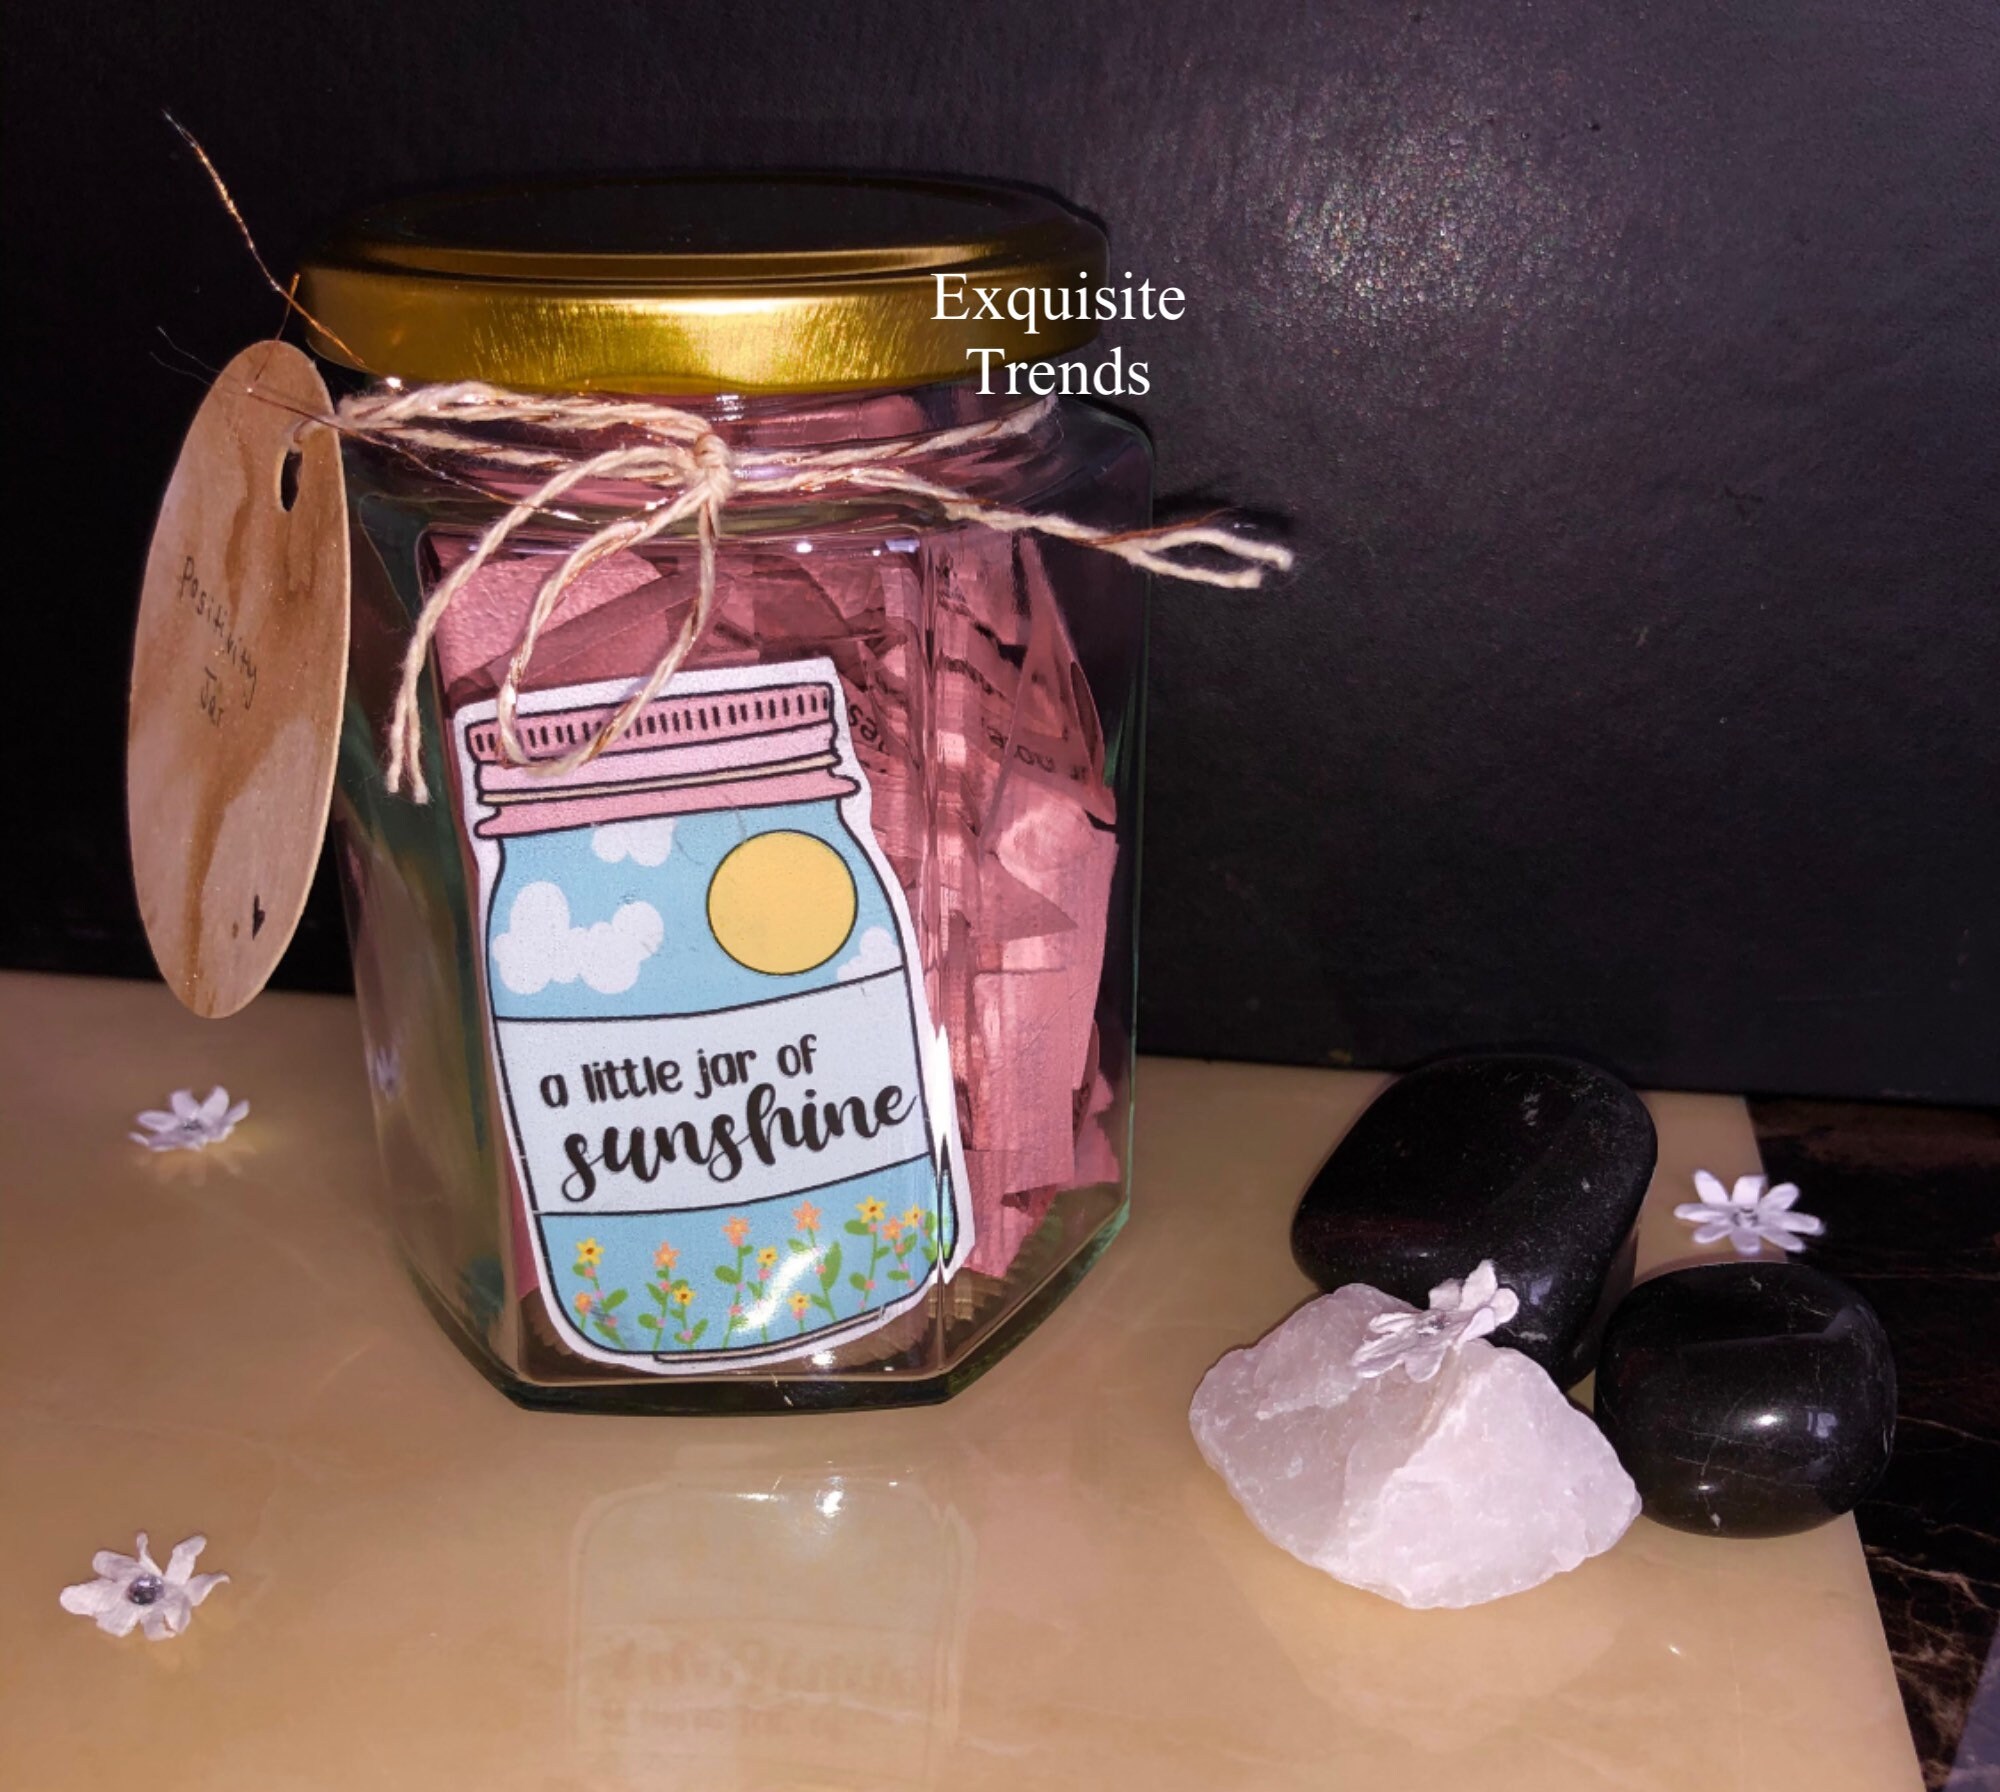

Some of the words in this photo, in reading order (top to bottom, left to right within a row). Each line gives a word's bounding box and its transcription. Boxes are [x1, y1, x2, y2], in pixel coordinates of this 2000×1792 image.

[539, 1073, 569, 1108] a
[581, 1056, 684, 1104] little
[695, 1047, 757, 1100] jar
[776, 1033, 818, 1077] of
[561, 1082, 919, 1203] sunshine
